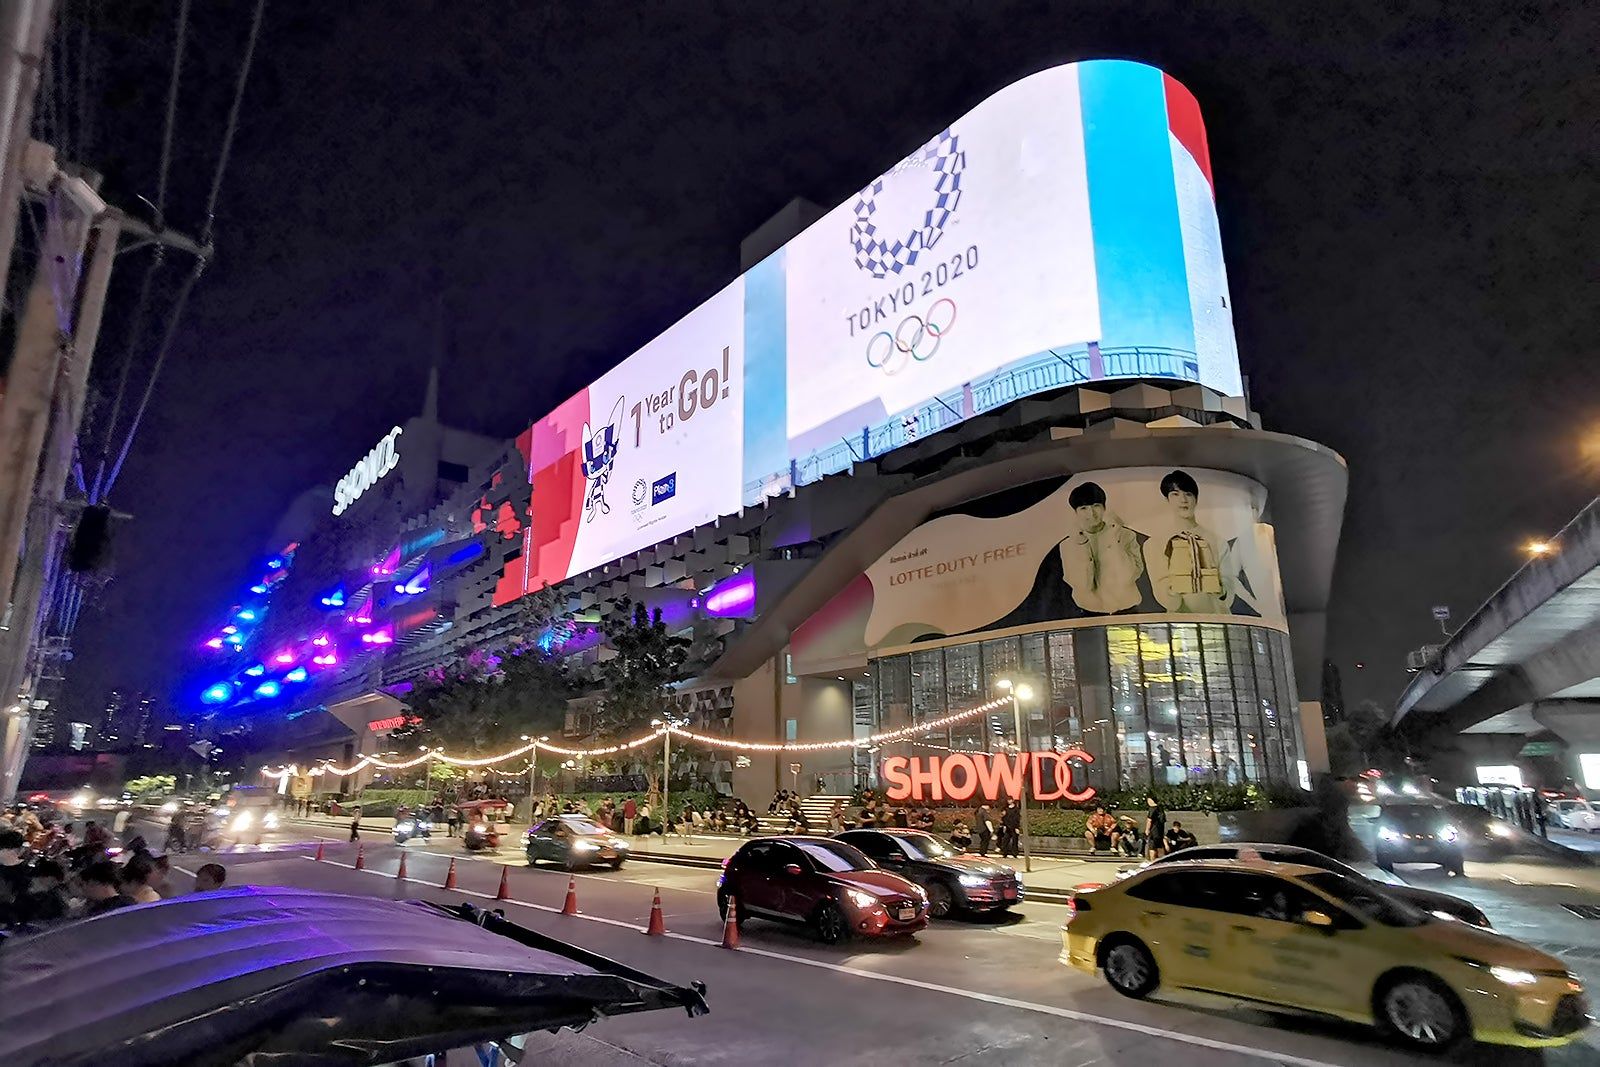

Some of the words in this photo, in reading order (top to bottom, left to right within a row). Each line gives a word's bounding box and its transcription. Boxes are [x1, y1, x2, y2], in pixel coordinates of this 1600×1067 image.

[847, 282, 915, 337] TOKYO
[921, 245, 979, 296] 2020
[645, 385, 675, 416] Year
[678, 345, 730, 422] Go!
[630, 401, 642, 447] 1
[659, 412, 674, 434] to
[889, 565, 934, 587] LOTTE
[936, 553, 978, 576] DUTY
[983, 542, 1026, 565] FREE
